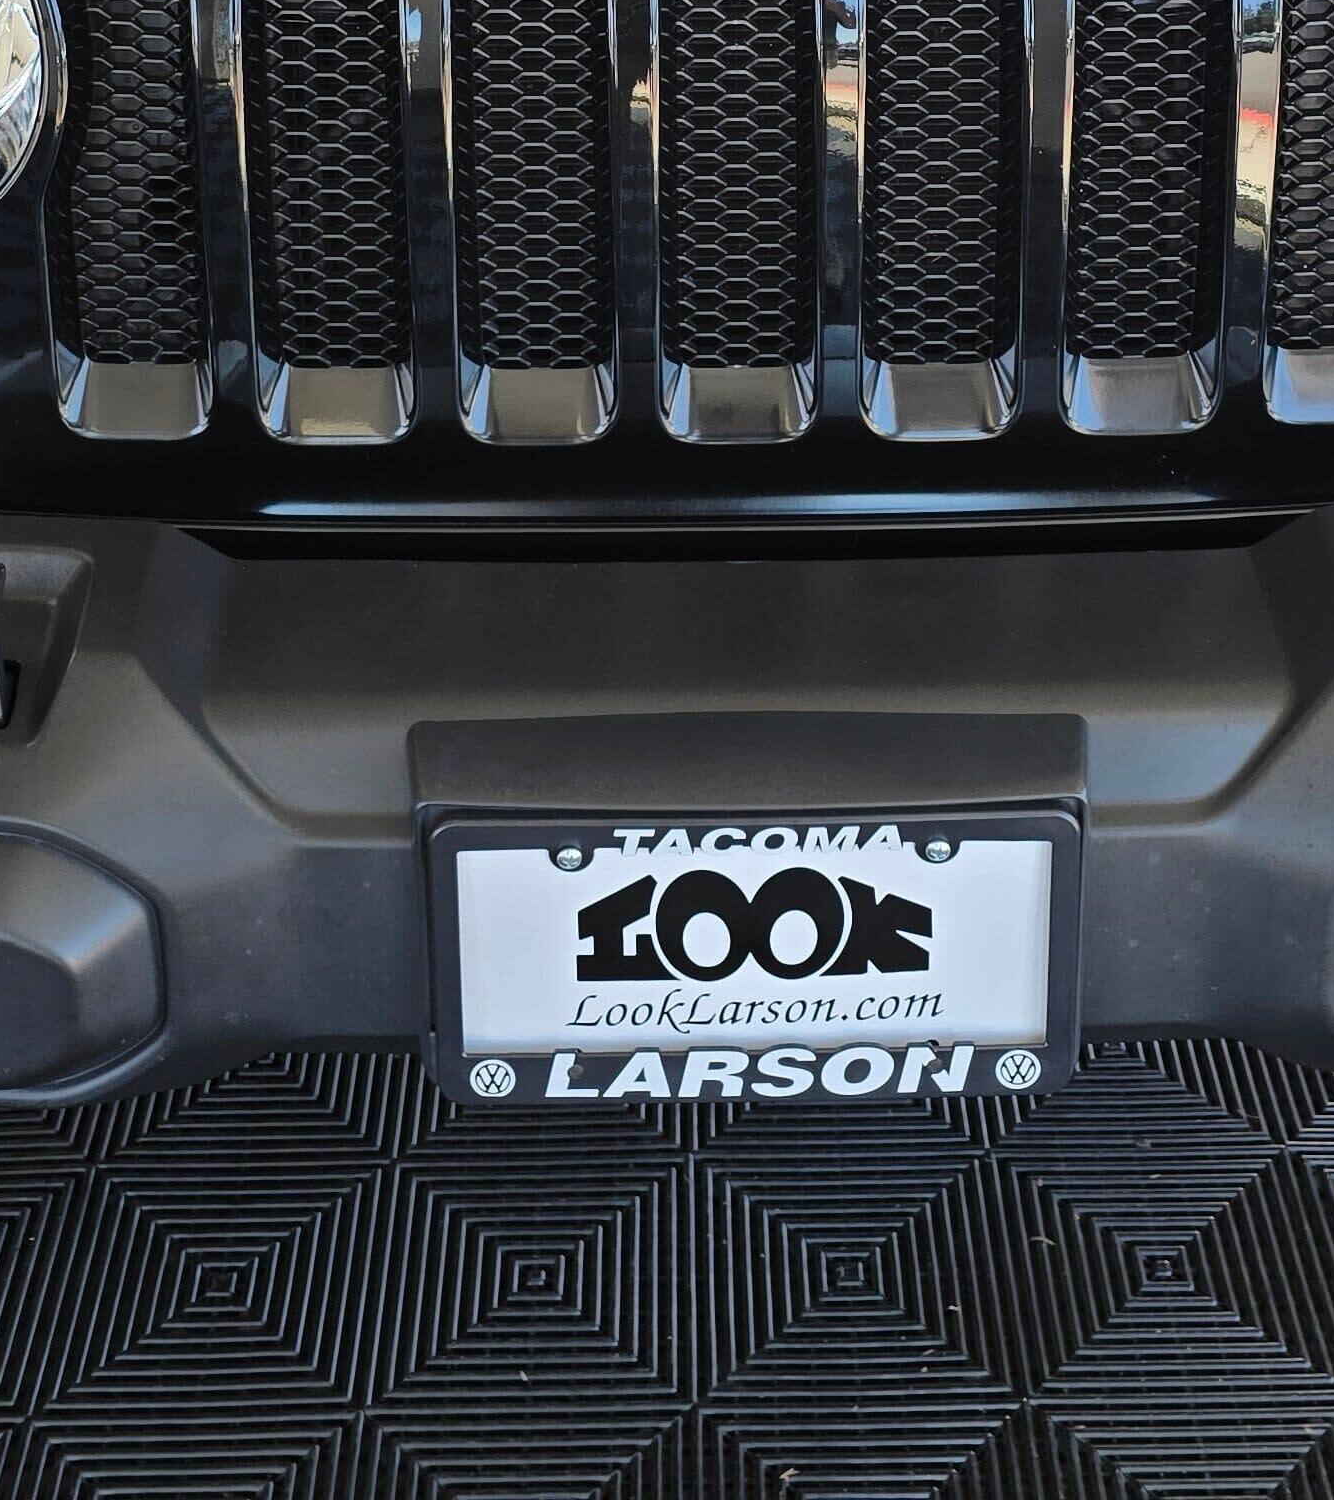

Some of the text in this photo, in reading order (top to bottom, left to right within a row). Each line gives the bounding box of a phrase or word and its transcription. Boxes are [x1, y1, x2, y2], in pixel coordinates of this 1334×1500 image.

[612, 824, 903, 858] TACOMA
[576, 866, 934, 982] LOOK
[566, 988, 946, 1035] LookLarson.com
[544, 1044, 975, 1099] LARSON
